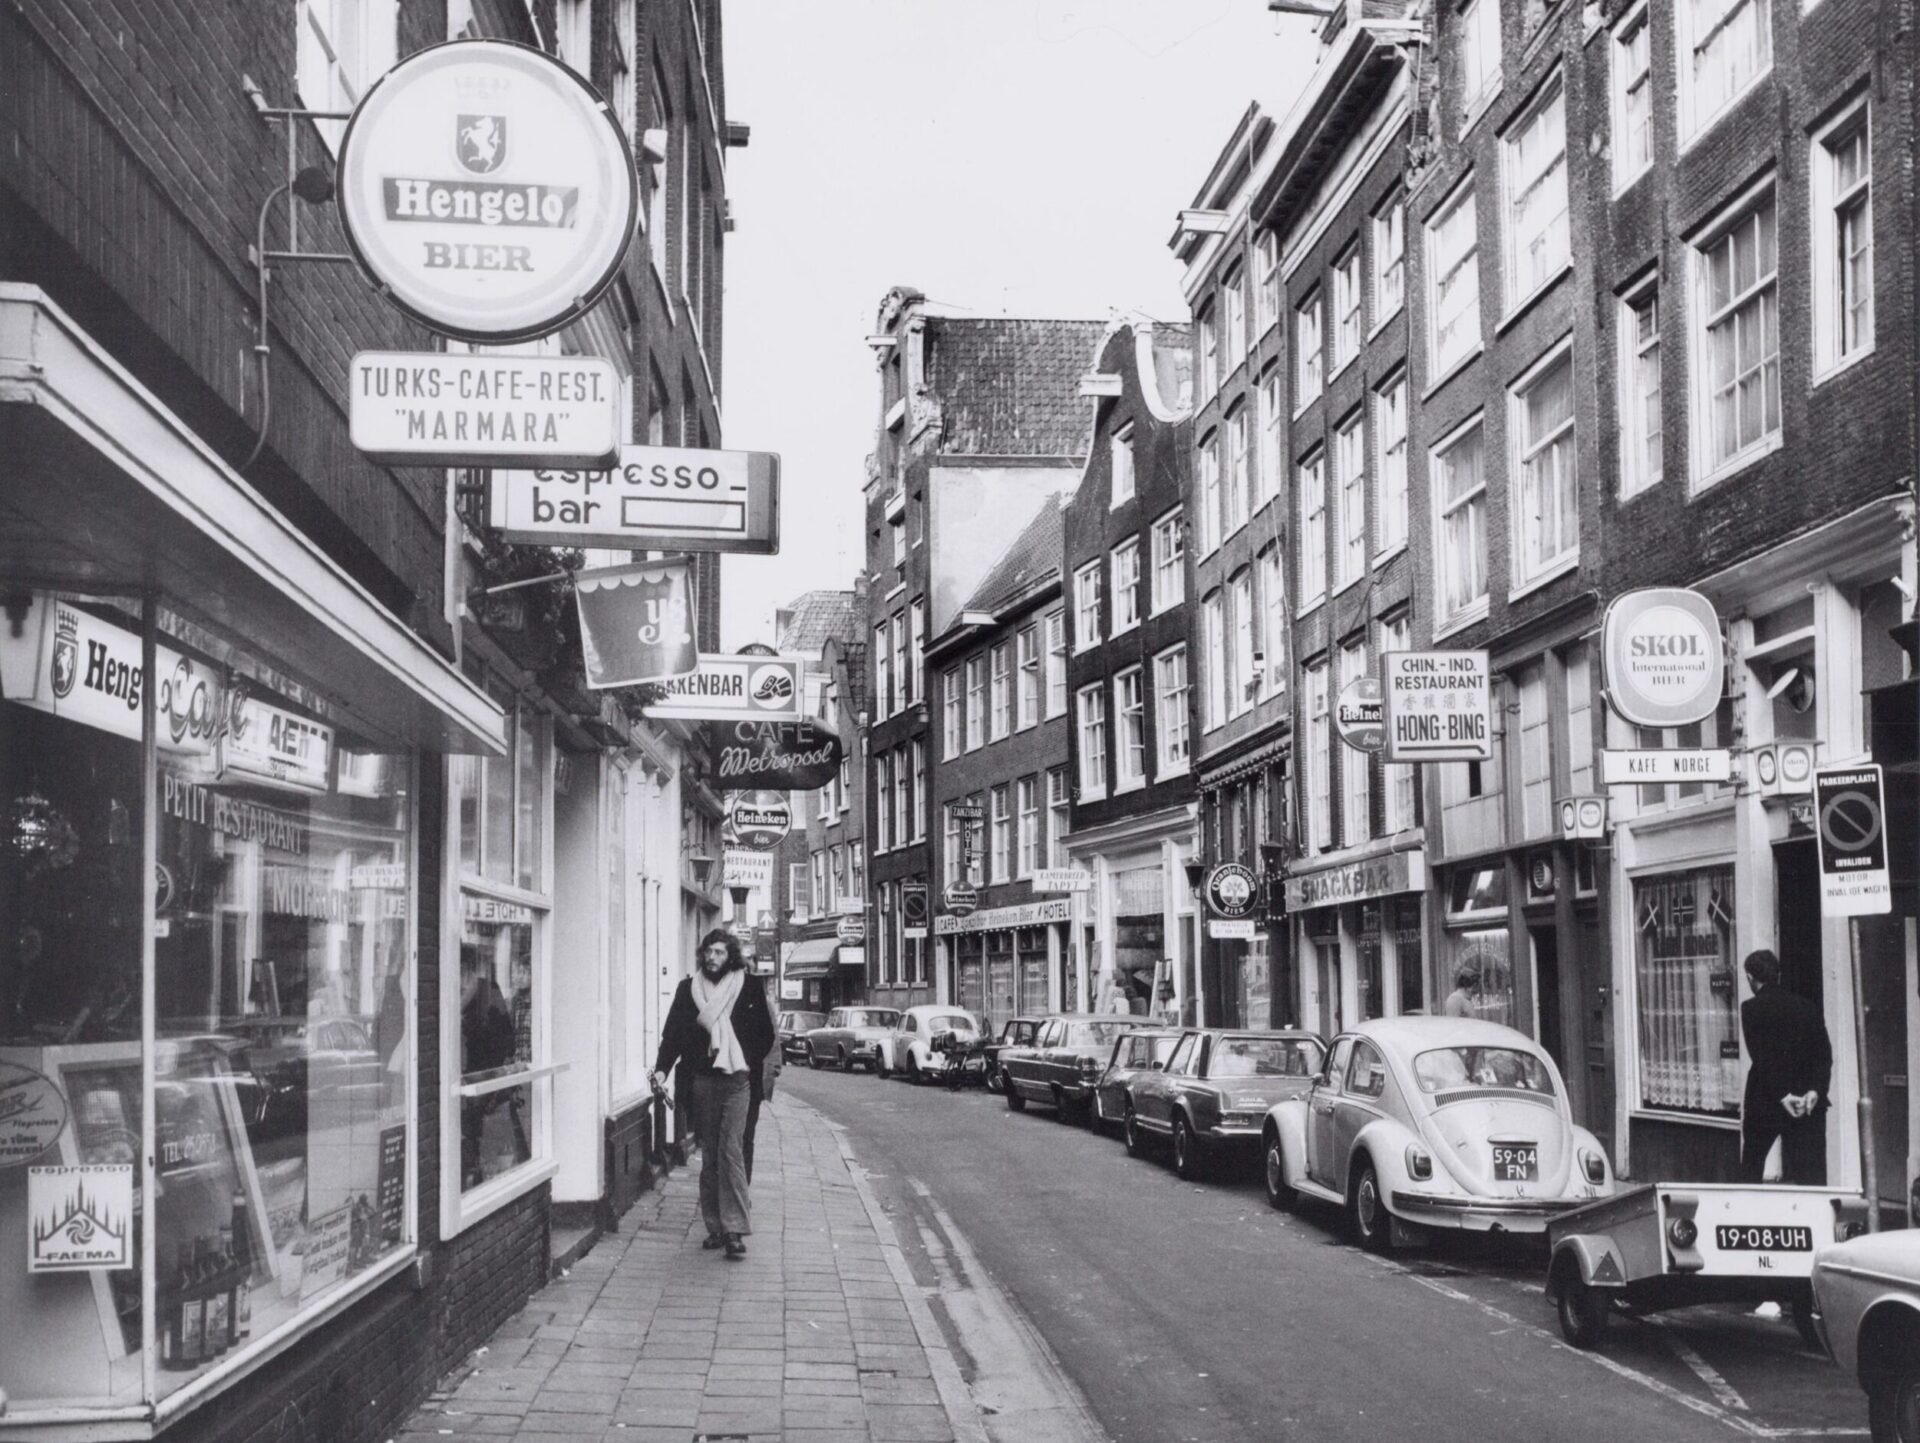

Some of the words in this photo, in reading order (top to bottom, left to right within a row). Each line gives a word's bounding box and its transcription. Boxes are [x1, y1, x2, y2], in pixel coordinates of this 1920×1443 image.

[396, 181, 563, 225] Hengelo
[424, 242, 534, 272] BIER
[360, 367, 605, 402] TURKS-CAFE-REST.
[533, 487, 601, 524] bar
[1631, 635, 1704, 657] SKOL
[1632, 661, 1705, 672] International
[1395, 675, 1484, 690] RESTAURANT
[719, 741, 834, 777] Metropool
[1629, 758, 1656, 773] KAFE
[1674, 757, 1711, 773] NORGE
[1819, 774, 1876, 786] PARKEERPLAATS
[164, 774, 207, 824] PETIT
[213, 794, 303, 854] RESTAURANT
[737, 811, 786, 824] Heineken
[953, 807, 983, 818] ZANZIBAR
[964, 822, 972, 866] HOTEL
[727, 857, 771, 867] RESTAURANT
[1835, 857, 1872, 867] INVALIDEN
[1211, 866, 1256, 891] Oranjeboom
[1044, 903, 1067, 919] HOTEL
[30, 1165, 130, 1175] espresso
[1507, 1165, 1527, 1179] FN
[46, 1250, 116, 1261] FAEMA
[1758, 1256, 1773, 1268] NL
